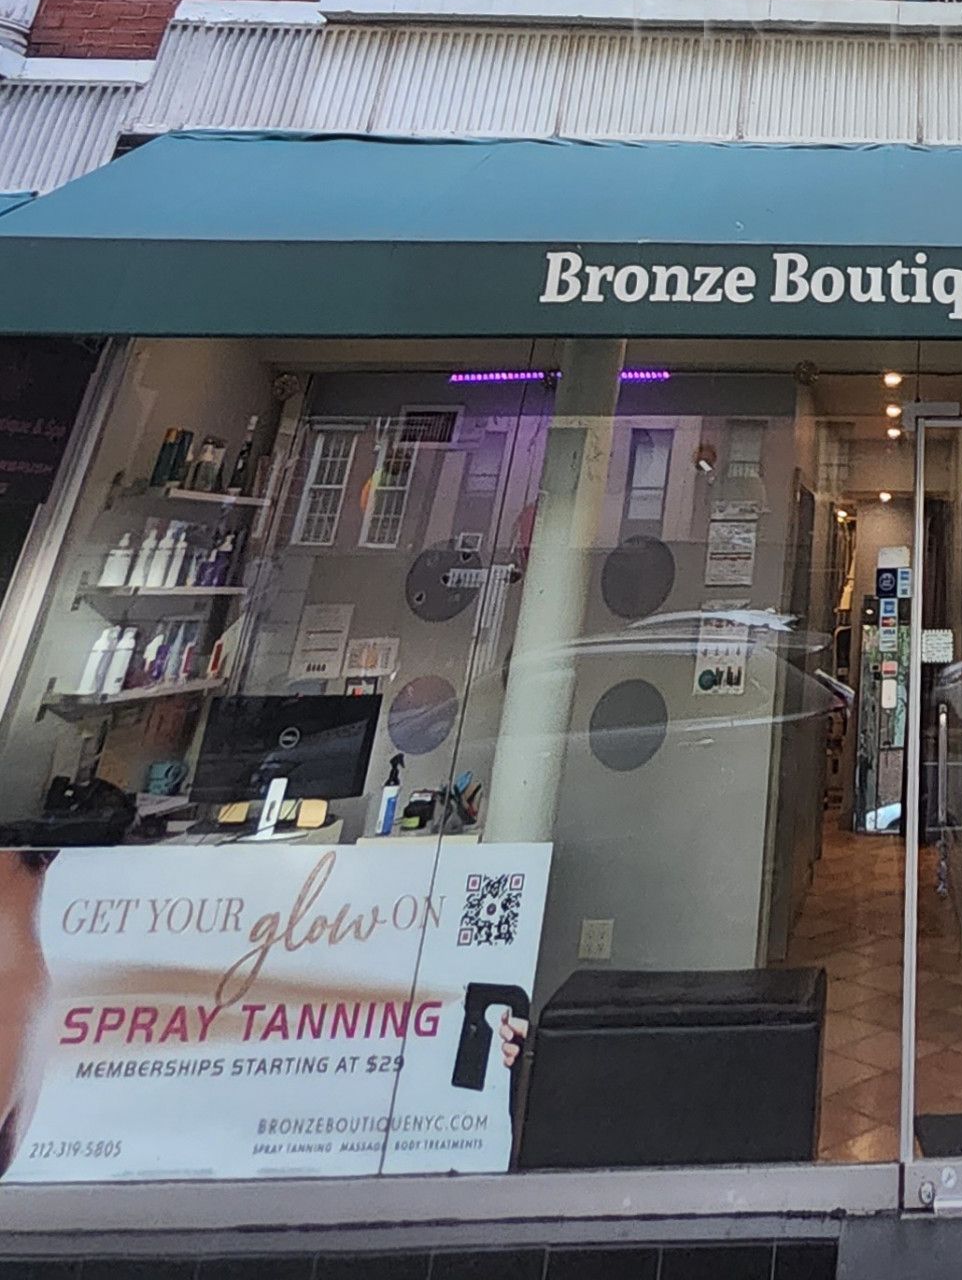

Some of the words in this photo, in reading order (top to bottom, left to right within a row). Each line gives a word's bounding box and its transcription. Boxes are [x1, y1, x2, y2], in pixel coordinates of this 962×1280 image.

[539, 251, 757, 303] Bronze
[62, 897, 140, 935] GET
[147, 896, 244, 934] YOUR
[215, 850, 387, 1007] glow
[392, 894, 447, 931] ON
[60, 1005, 222, 1044] SPRAY
[241, 1001, 443, 1041] TANNING
[75, 1058, 225, 1079] MEMBERSHIPS
[231, 1055, 329, 1076] STARTING
[334, 1056, 360, 1074] AT
[366, 1054, 405, 1073] $29
[286, 1142, 333, 1153] TANNING
[394, 1139, 421, 1151] BODY
[424, 1138, 484, 1150] TREATMENTS
